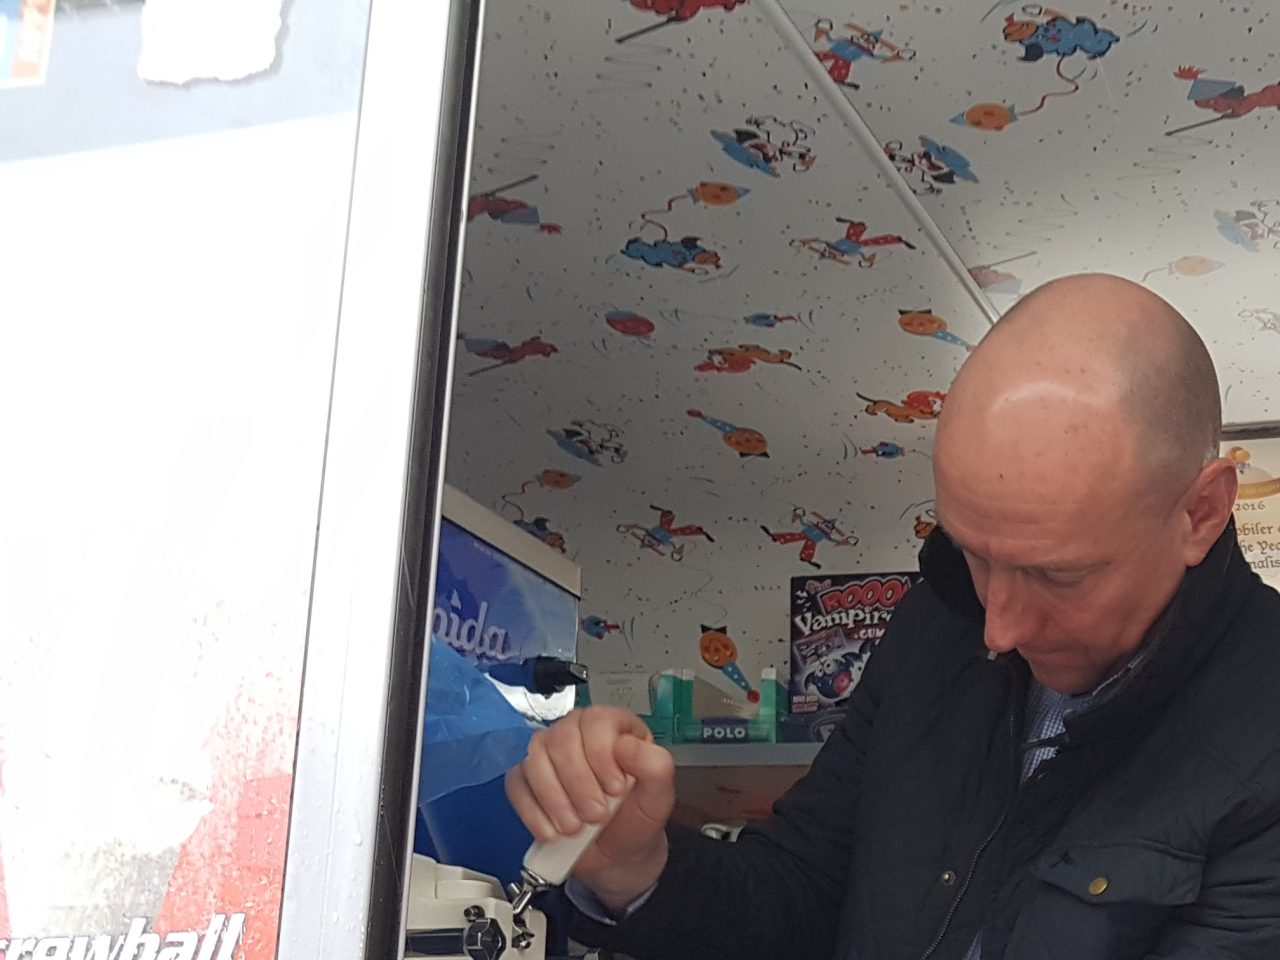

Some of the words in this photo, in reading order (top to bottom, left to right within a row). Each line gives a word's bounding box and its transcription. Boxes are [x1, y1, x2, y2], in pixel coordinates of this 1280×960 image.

[1235, 501, 1266, 512] 2016
[1236, 523, 1273, 537] obiler
[1240, 541, 1254, 555] he
[703, 726, 746, 740] POLO
